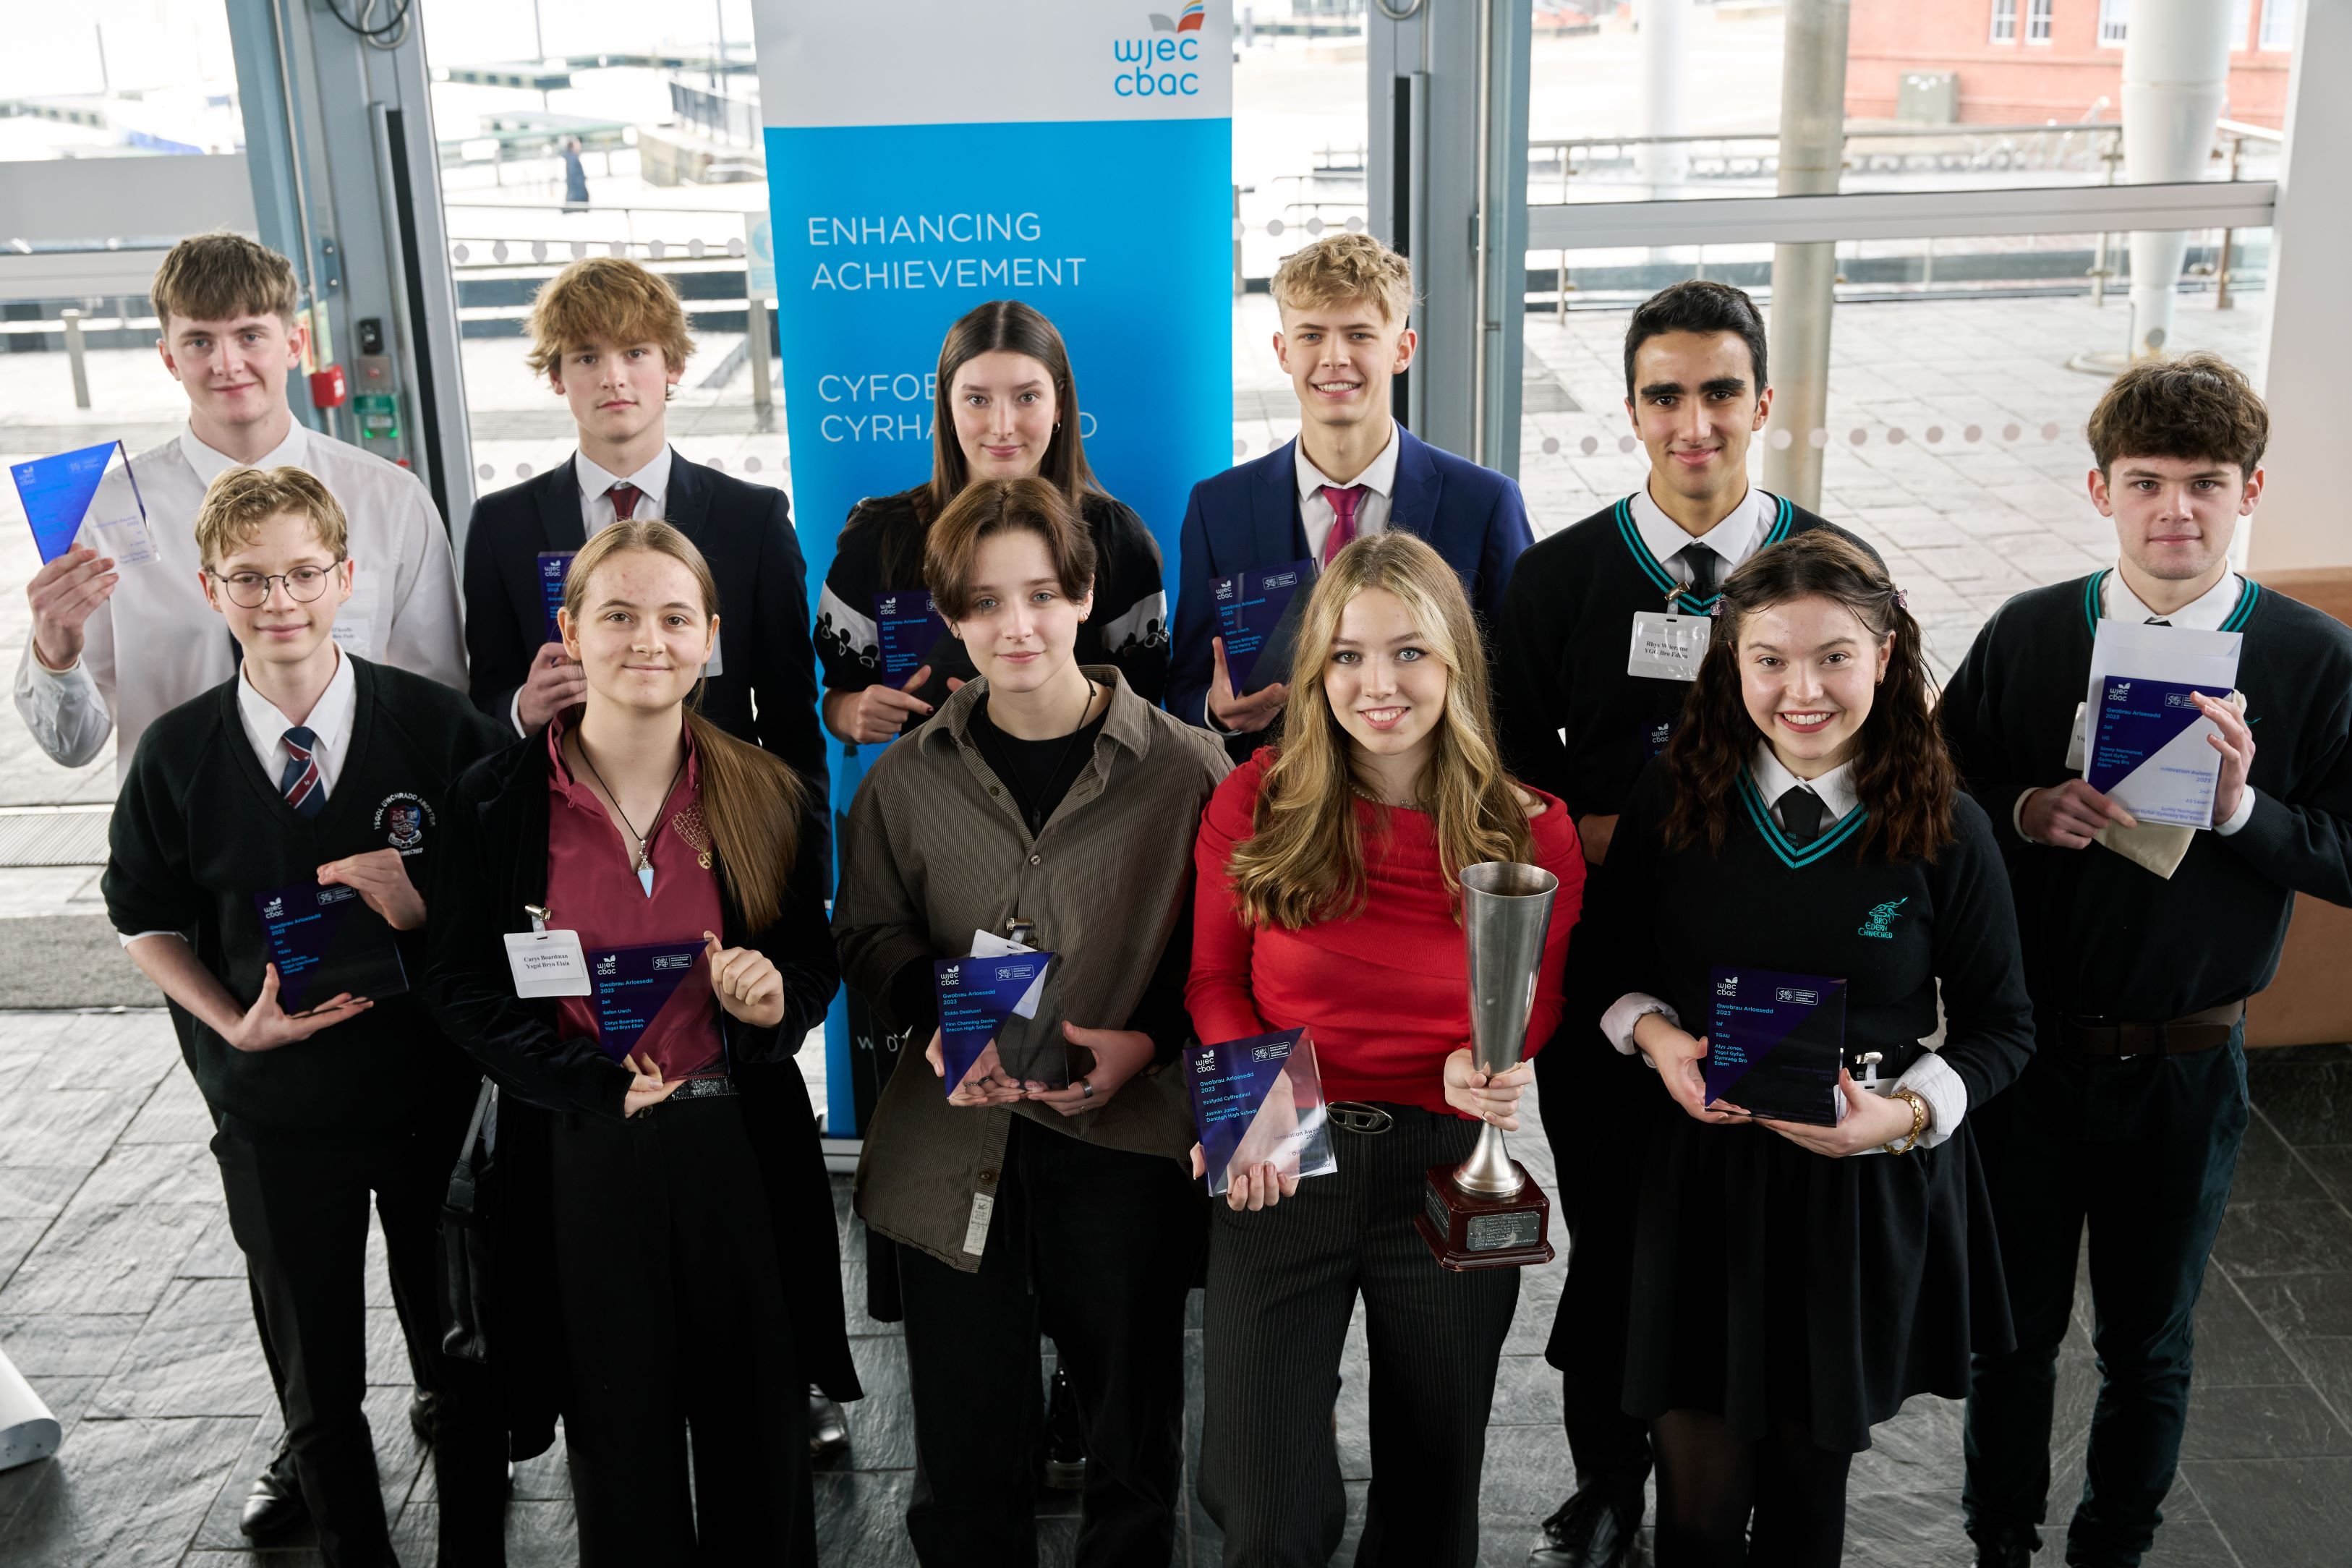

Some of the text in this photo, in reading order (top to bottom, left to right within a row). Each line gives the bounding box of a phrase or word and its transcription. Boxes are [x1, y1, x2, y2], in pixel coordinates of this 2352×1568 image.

[1114, 38, 1198, 69] wjec
[1114, 67, 1199, 96] cbac
[809, 212, 1041, 246] ENHANCING
[811, 257, 1086, 291] ACHIEVEMENT
[818, 373, 937, 403] CYFOE
[373, 807, 384, 830] YSGOL
[380, 793, 418, 807] UWCHRADD
[263, 904, 282, 913] wjec
[265, 910, 284, 919] cbac
[1195, 1057, 1214, 1066] wjec
[1196, 1064, 1215, 1073] cbac
[1199, 1072, 1254, 1086] Gwobrau Arloesedd
[1203, 1091, 1251, 1105] Enillydd Cyffredinol
[1240, 1108, 1257, 1117] School
[1274, 1130, 1303, 1141] Innovation
